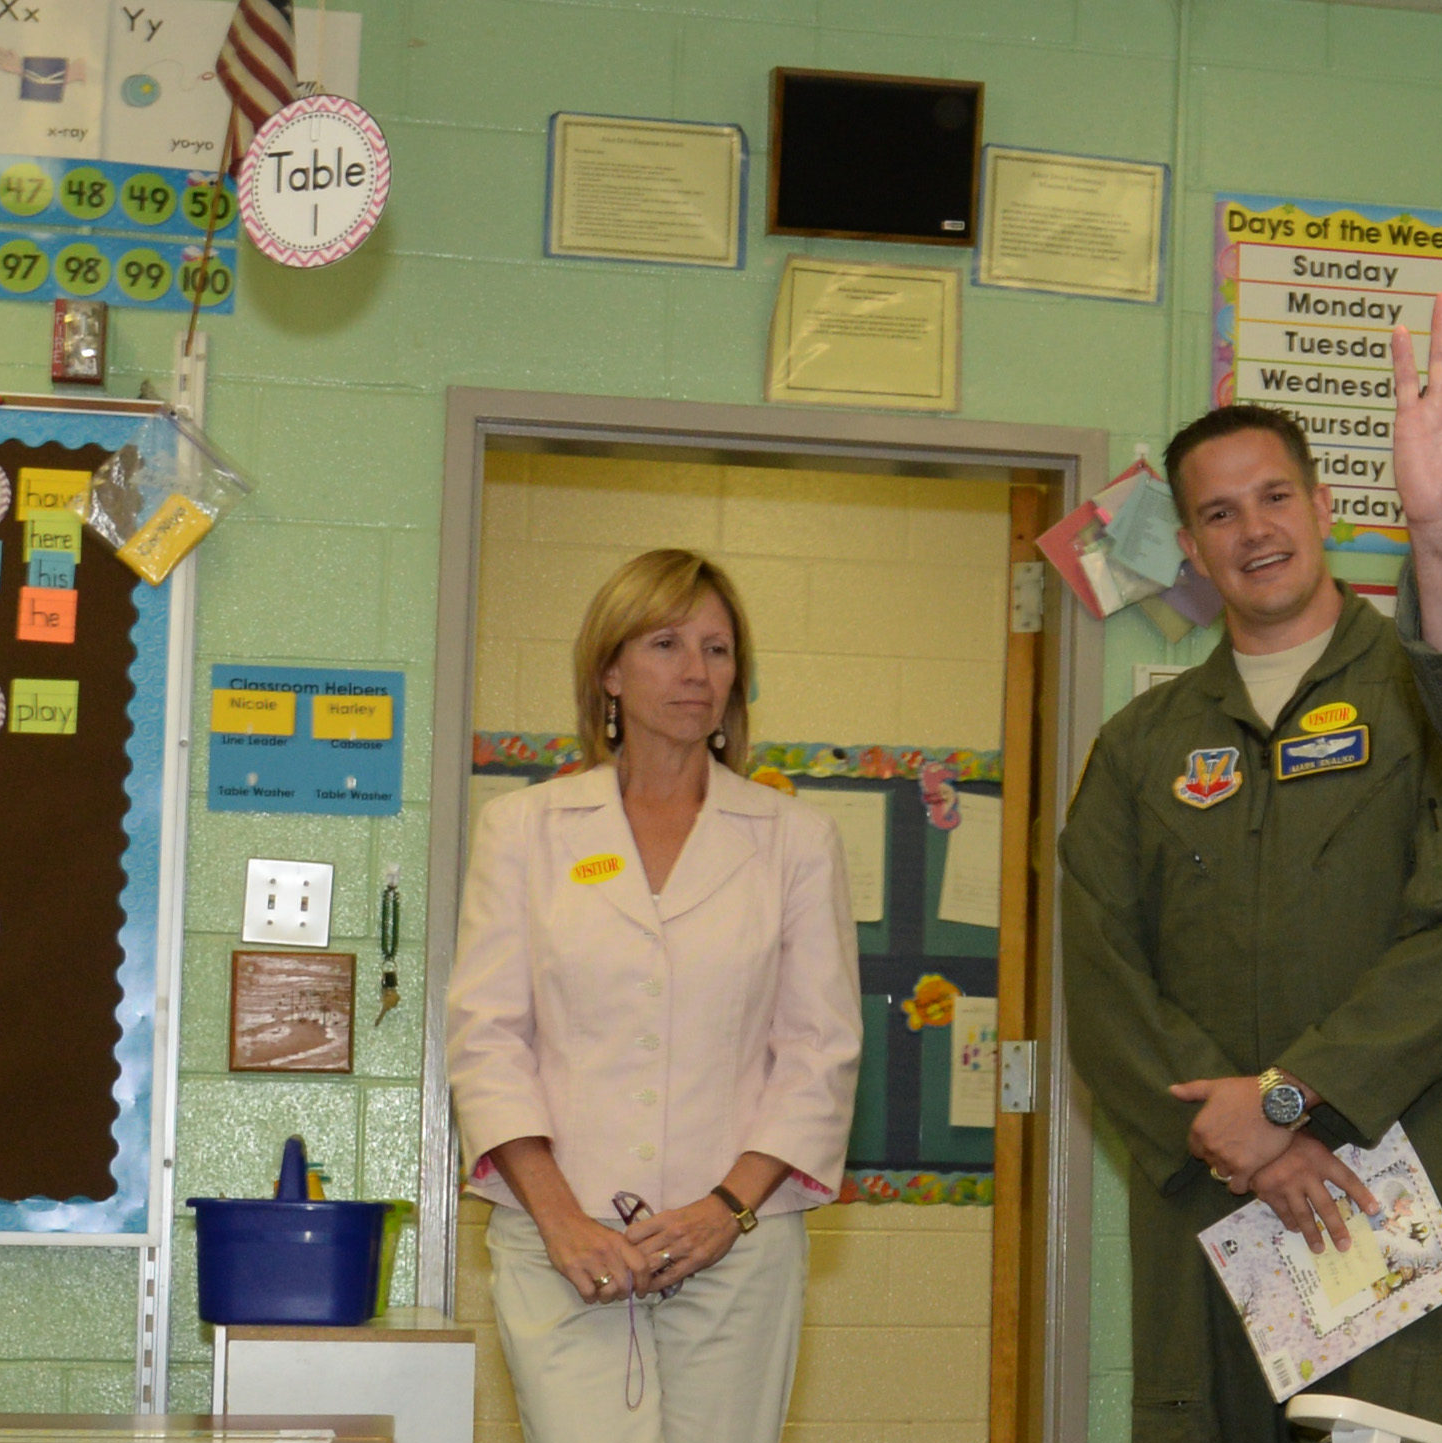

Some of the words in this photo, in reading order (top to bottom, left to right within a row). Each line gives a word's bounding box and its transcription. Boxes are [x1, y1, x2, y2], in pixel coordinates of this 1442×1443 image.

[47, 126, 89, 142] x-ray
[171, 137, 215, 153] yo-yo
[267, 148, 367, 194] Table
[66, 180, 107, 209] 48
[189, 190, 230, 221] 50
[1228, 209, 1295, 241] Days
[1305, 217, 1330, 240] of
[1339, 220, 1382, 244] the
[1292, 254, 1399, 288] Sunday
[1287, 291, 1403, 326] Monday
[1284, 330, 1391, 360] Tuesda
[1291, 409, 1392, 440] hursda
[1313, 451, 1386, 482] riday
[26, 479, 85, 508] hav
[30, 519, 73, 549] here
[38, 562, 70, 588] his
[31, 597, 60, 628] he
[229, 677, 320, 695] Classroom
[324, 682, 389, 696] Helpers
[16, 694, 73, 734] play
[230, 697, 278, 711] Nicole
[1307, 706, 1351, 727] VISITOR
[222, 735, 245, 746] Line
[248, 735, 288, 748] Leader
[330, 739, 383, 751] Caboose
[219, 785, 250, 797] Table
[253, 786, 296, 798] Washer
[316, 788, 347, 800] Table
[350, 790, 393, 801] Washer
[575, 856, 620, 879] VISITOR
